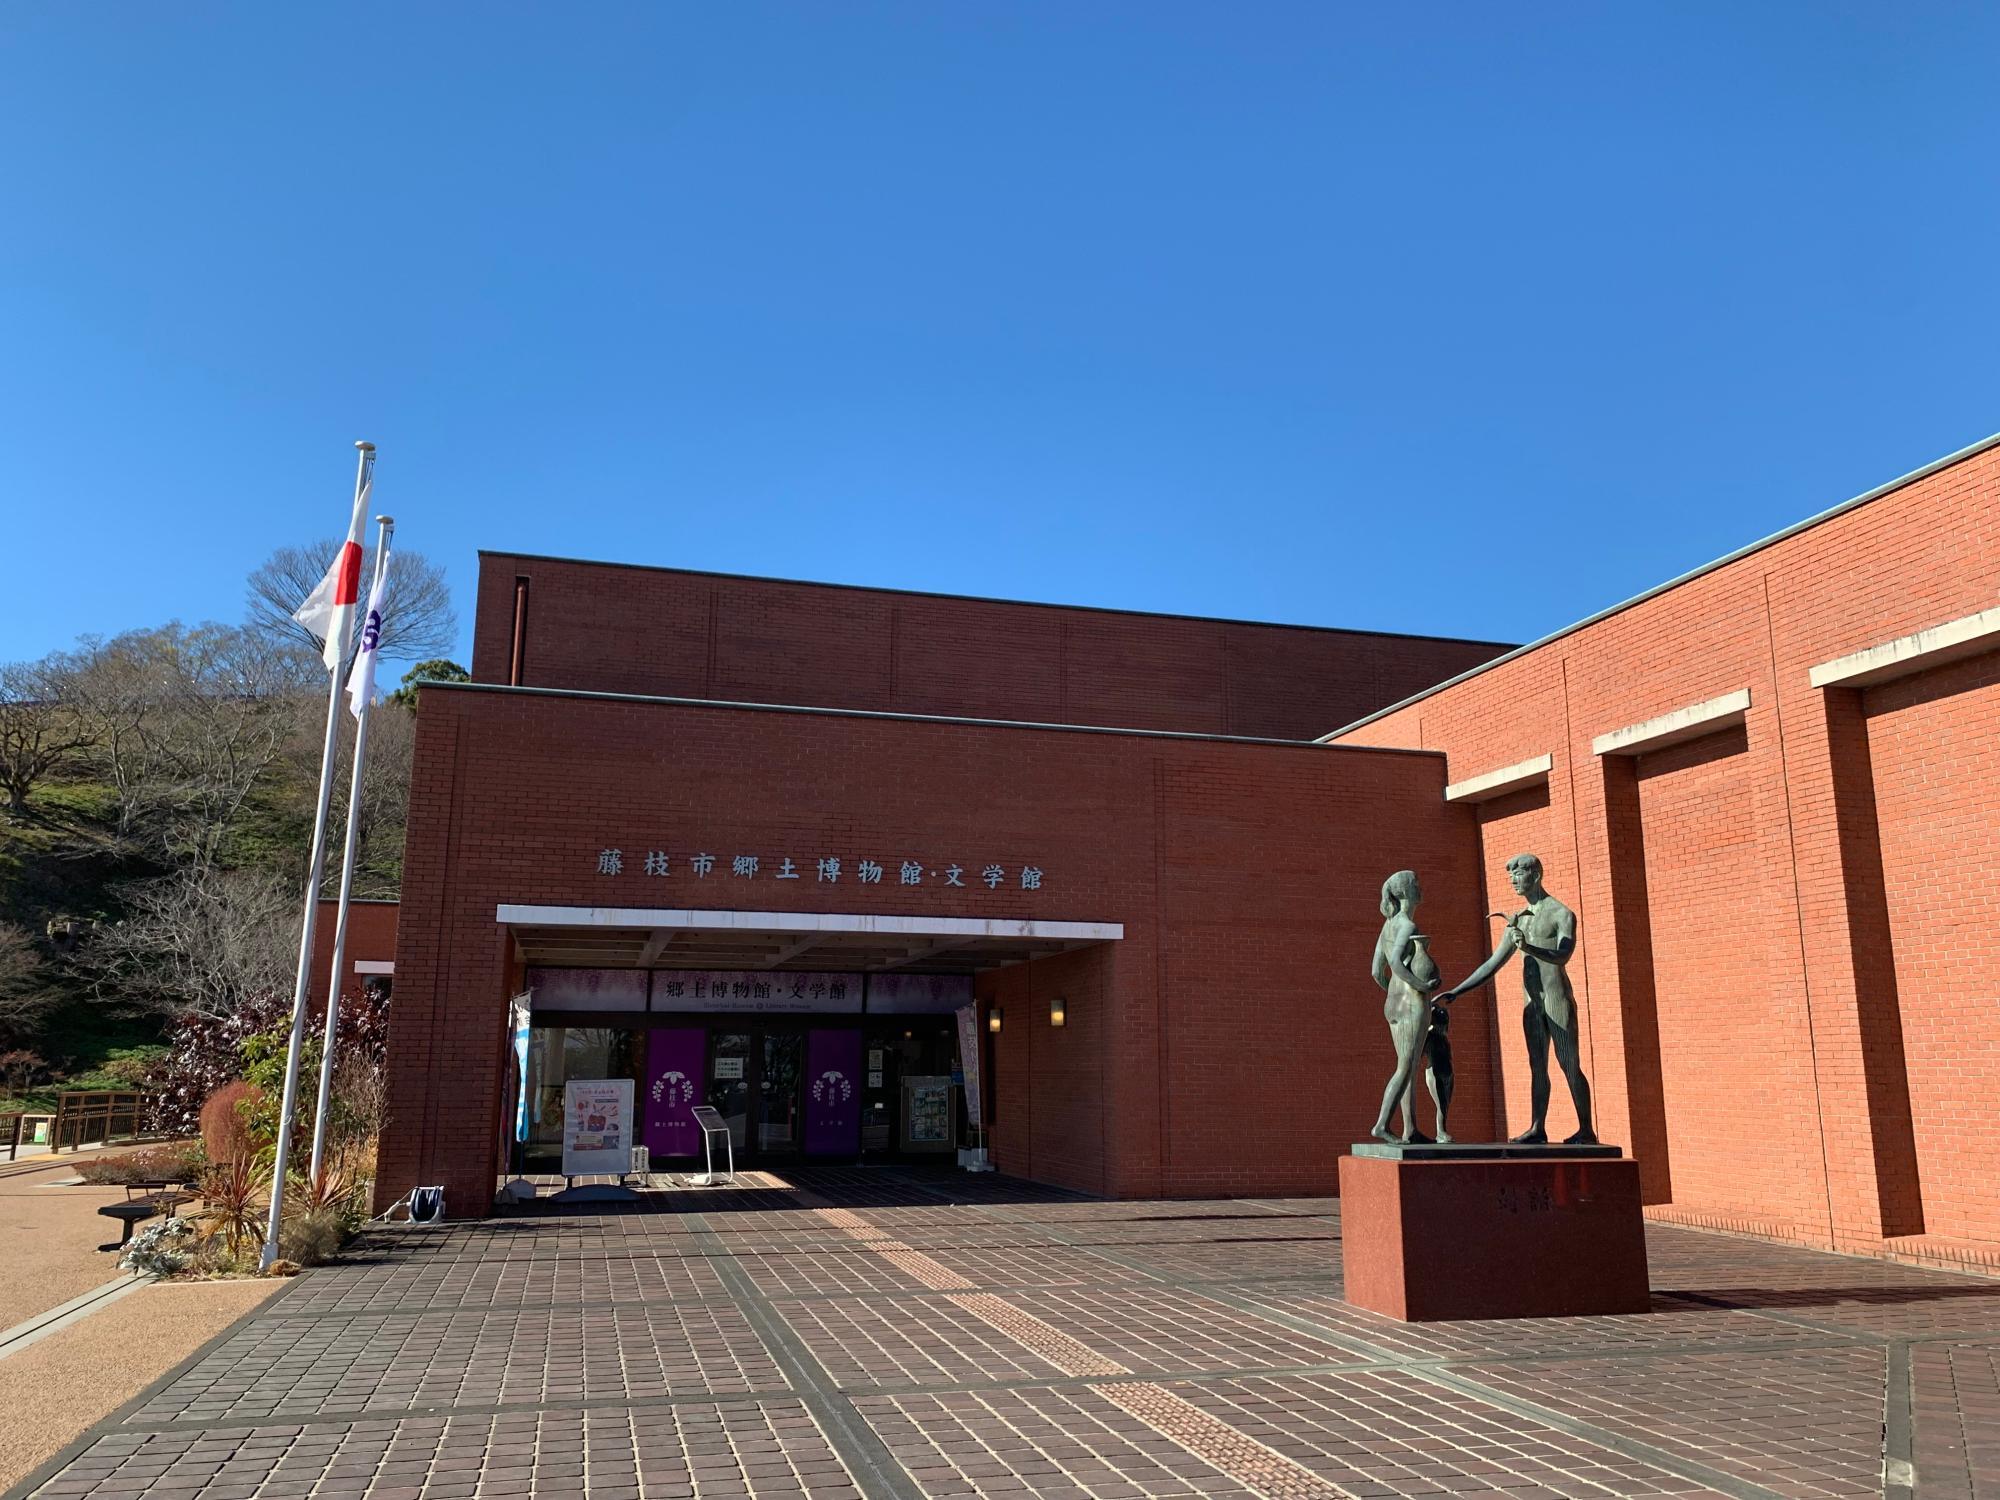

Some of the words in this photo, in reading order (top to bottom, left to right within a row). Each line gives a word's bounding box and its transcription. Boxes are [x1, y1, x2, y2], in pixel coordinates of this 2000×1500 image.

[596, 849, 1044, 891] 藤枝市郷土博物館・文学館
[666, 981, 848, 1000] 郷土博物館・文学館
